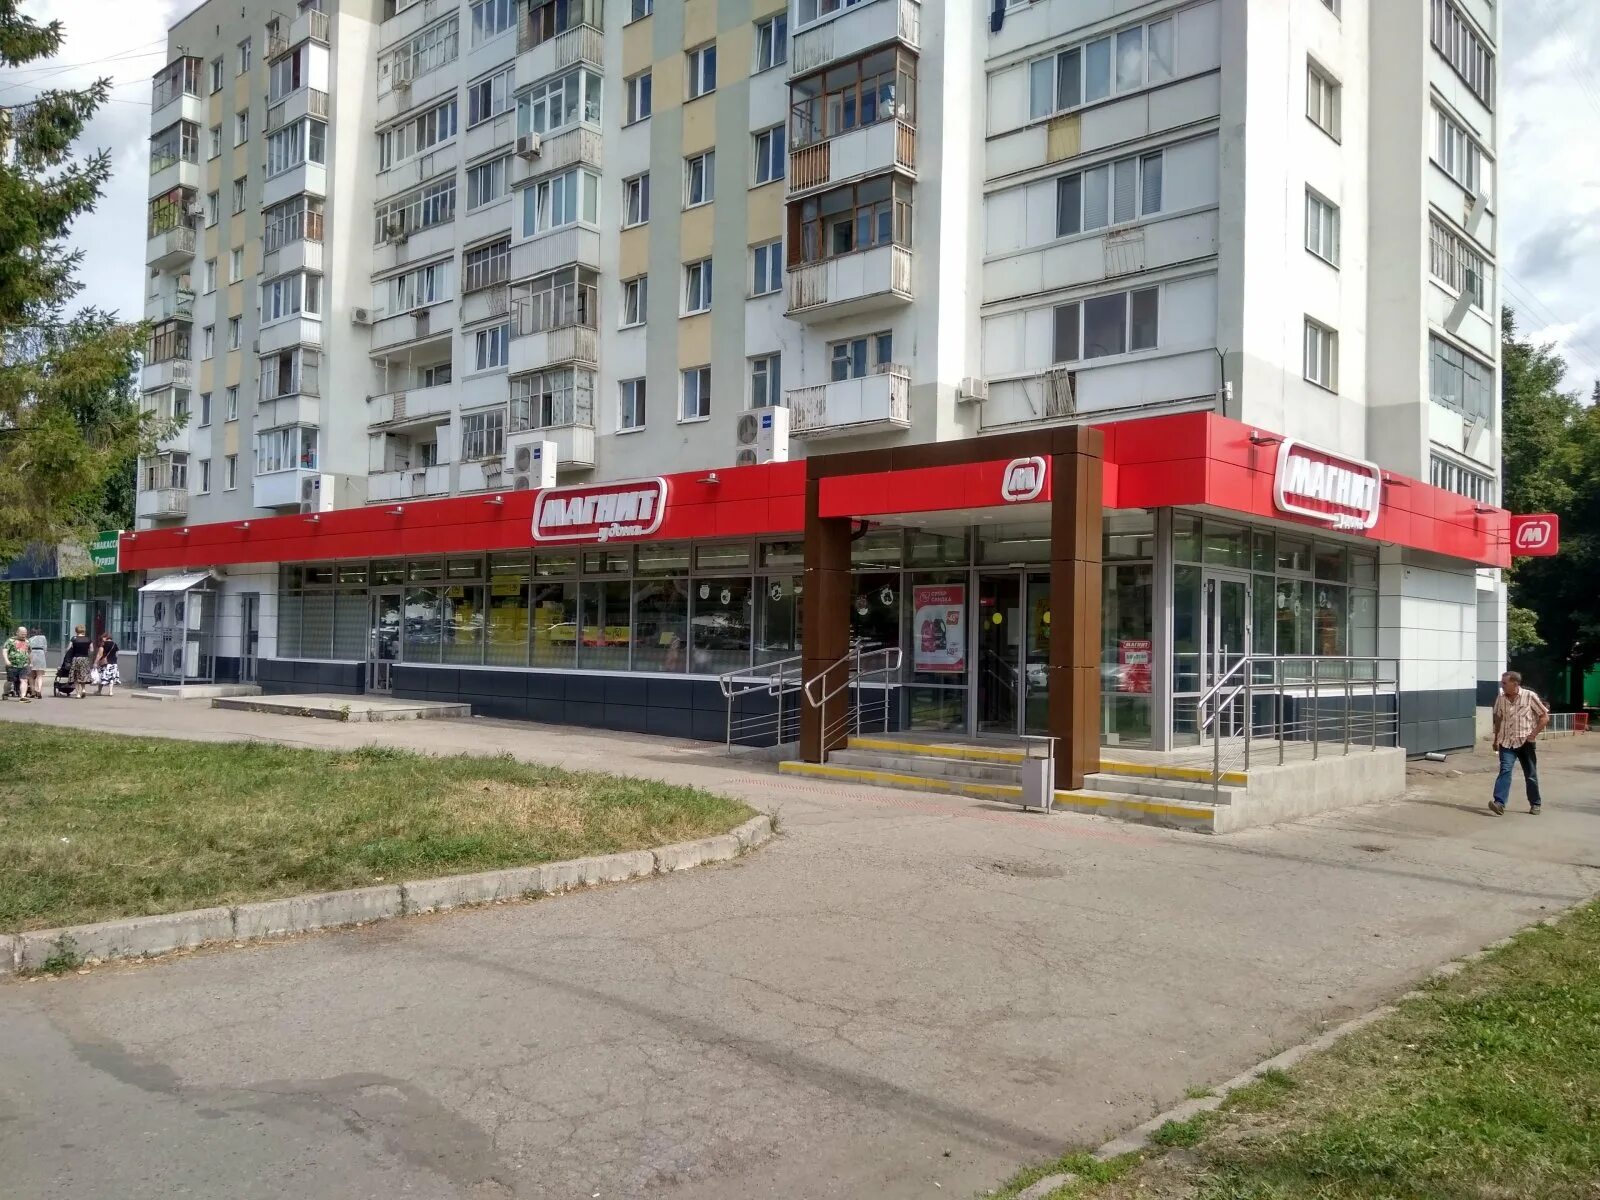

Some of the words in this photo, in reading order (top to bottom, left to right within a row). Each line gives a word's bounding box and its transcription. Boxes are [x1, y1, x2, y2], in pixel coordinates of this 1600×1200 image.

[1008, 466, 1036, 491] М
[1283, 455, 1376, 511] МАГНИТ
[539, 490, 658, 527] МАГНИТ
[608, 522, 642, 537] дома
[1520, 527, 1542, 542] М
